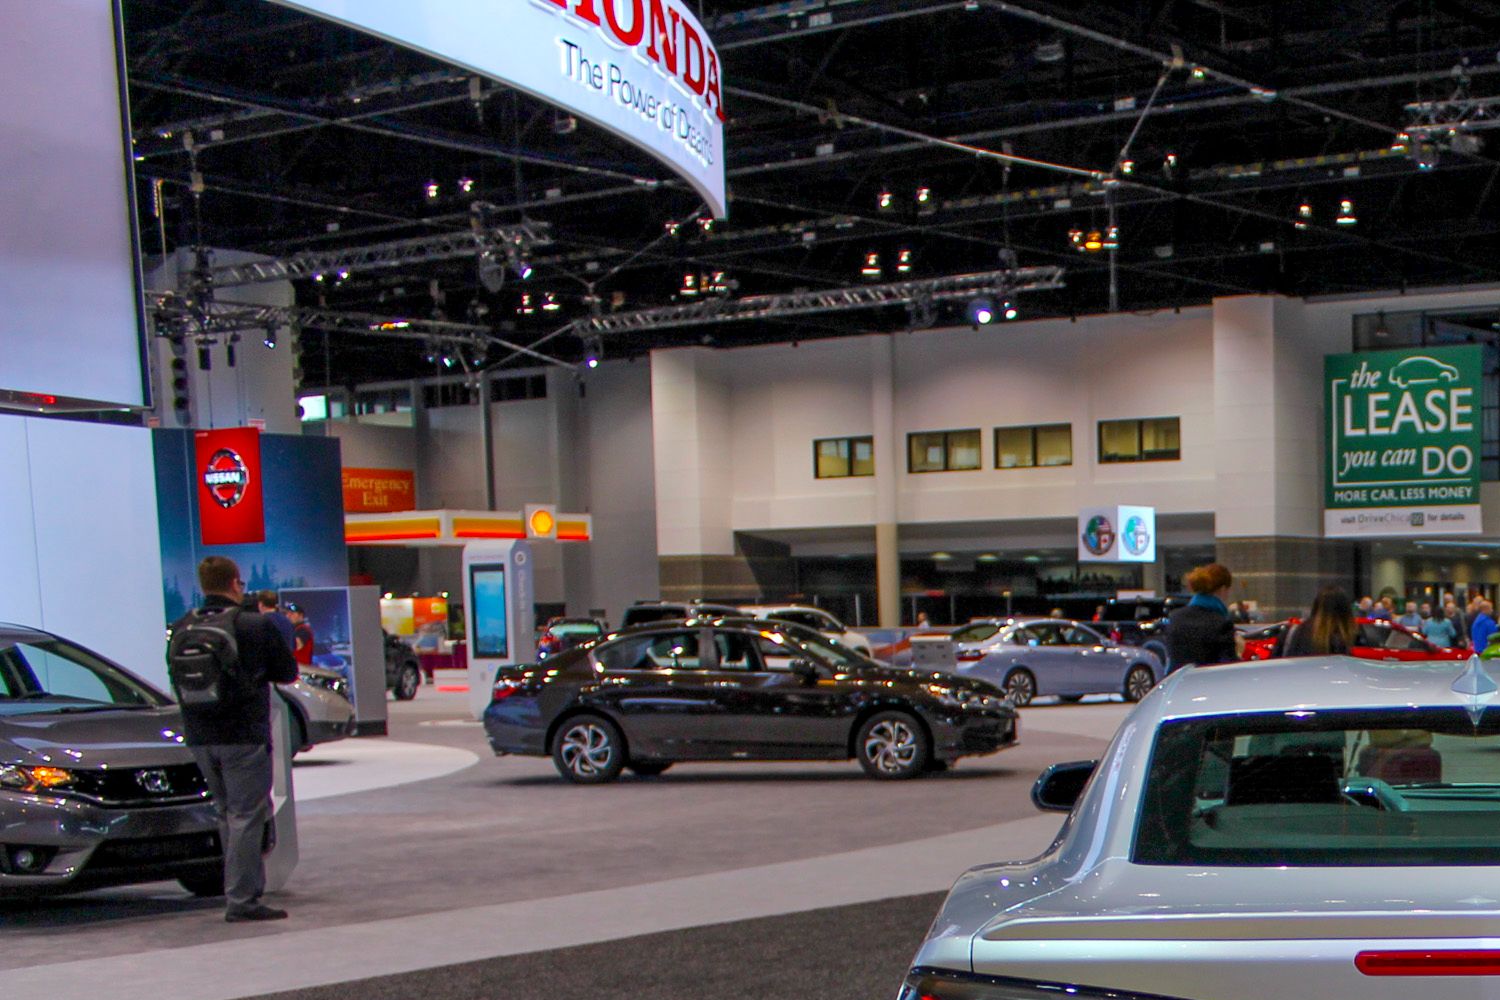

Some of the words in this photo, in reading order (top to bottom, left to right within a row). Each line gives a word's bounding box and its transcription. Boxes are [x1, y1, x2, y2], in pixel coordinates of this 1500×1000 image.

[561, 39, 603, 90] The
[608, 63, 662, 119] Power
[1351, 361, 1381, 388] the
[1344, 388, 1473, 436] LEASE
[1338, 450, 1376, 476] you
[1381, 448, 1416, 466] can
[1422, 445, 1473, 475] DO
[205, 472, 240, 484] NISSAN
[363, 491, 389, 506] Exit
[1334, 490, 1367, 502] MORE
[1400, 488, 1425, 501] LESS
[1428, 486, 1472, 499] MONEY
